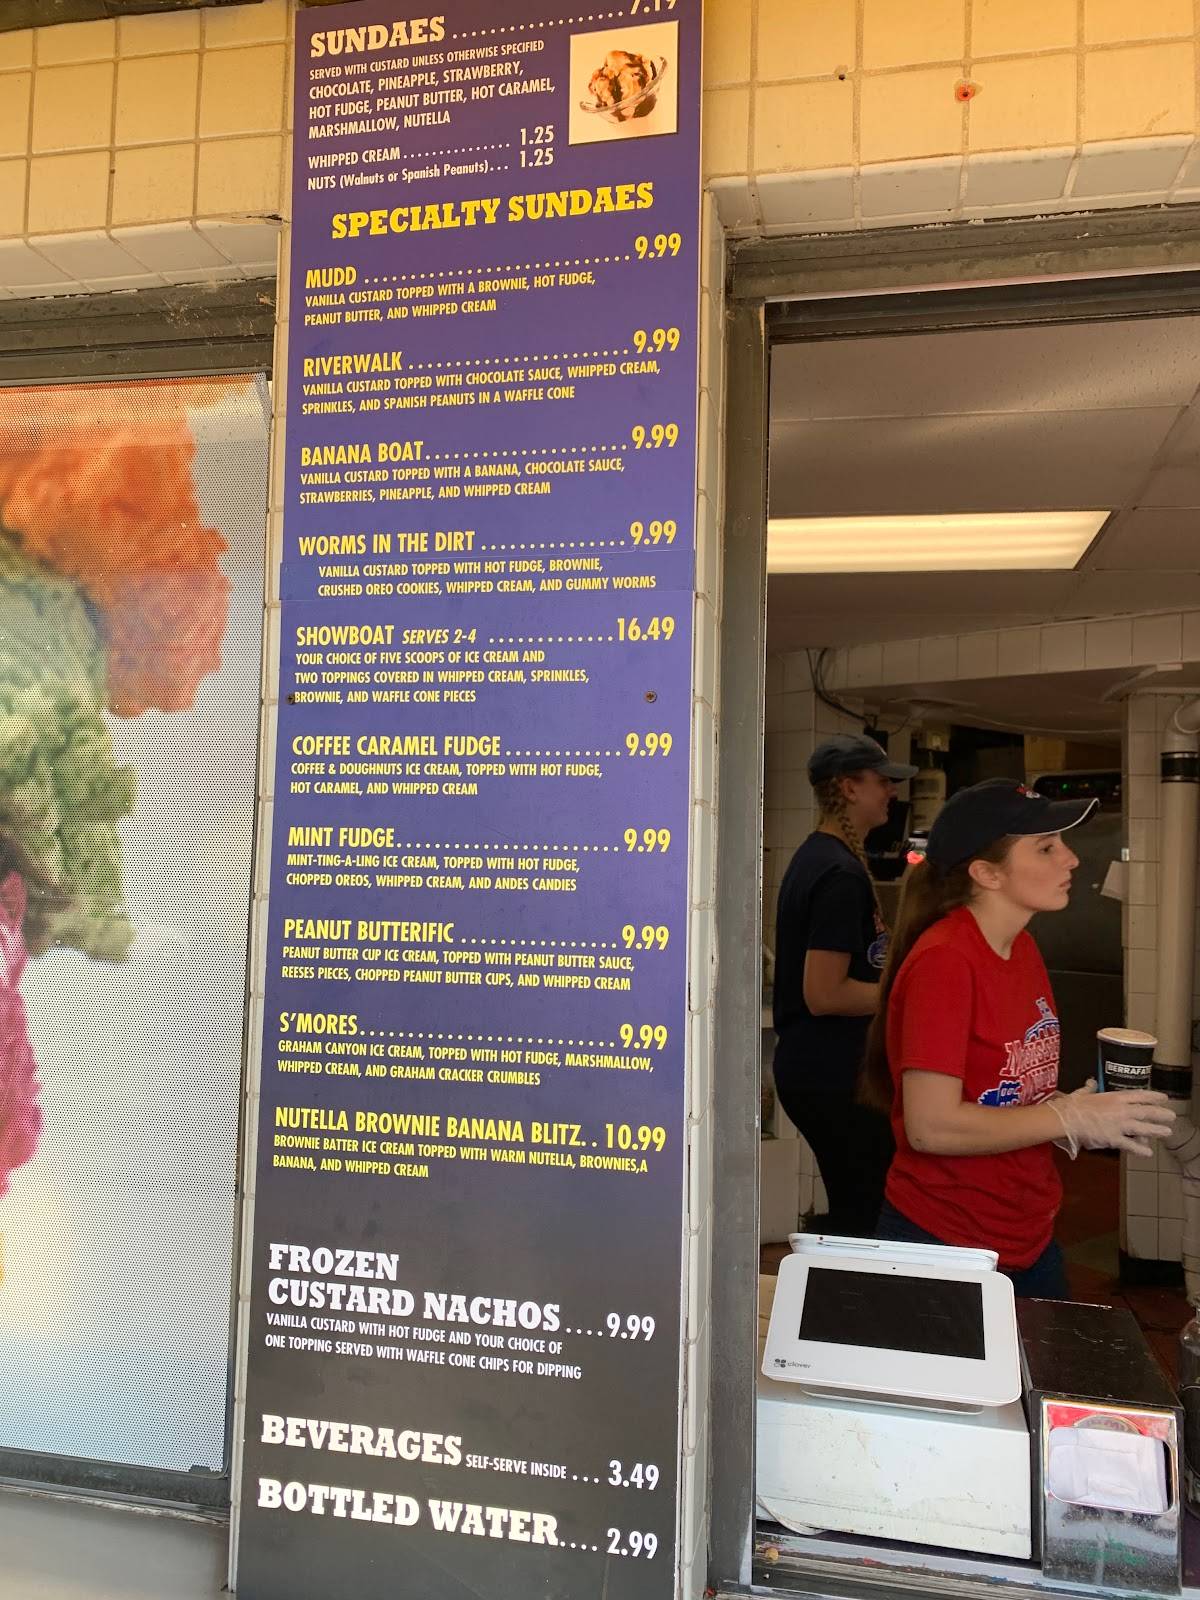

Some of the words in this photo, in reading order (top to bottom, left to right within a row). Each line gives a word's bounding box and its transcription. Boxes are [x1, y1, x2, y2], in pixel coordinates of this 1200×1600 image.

[311, 16, 445, 57] SUNDAES
[310, 67, 341, 80] SERVED
[345, 63, 367, 75] WITH
[370, 58, 409, 72] CUSTARD
[412, 53, 444, 67] UNLESS
[447, 46, 498, 62] OTHERWISE
[501, 40, 544, 55] SPECIFIED
[310, 80, 374, 99] CHOCOLATE,
[379, 72, 439, 91] PINEAPPLE,
[443, 61, 523, 83] STRAWBERRY,
[310, 105, 331, 119] HOT
[335, 100, 372, 116] FUDGE,
[377, 94, 419, 111] PEANUT
[423, 89, 467, 105] BUTTER,
[472, 85, 495, 100] HOT
[499, 78, 555, 96] CARAMEL,
[309, 117, 399, 139] MARSHMALLOW,
[404, 110, 450, 128] NUTELLA
[308, 152, 358, 169] WHIPPED
[362, 147, 400, 163] CREAM
[521, 125, 554, 145] 1.25
[308, 175, 336, 190] NUTS
[340, 172, 384, 188] (Walnuts
[388, 172, 398, 182] or
[402, 164, 440, 183] Spanish
[444, 160, 488, 176] Peanuts)
[520, 147, 553, 167] 1.25
[332, 198, 500, 239] SPECIALTY
[509, 182, 653, 221] SUNDAES
[306, 267, 356, 288] MUDD
[635, 233, 681, 259] 9.99
[305, 312, 342, 326] PEANUT
[345, 309, 383, 322] BUTTER,
[387, 307, 408, 319] AND
[412, 303, 458, 317] WHIPPED
[461, 299, 496, 313] CREAM
[304, 351, 402, 377] RIVERWALK
[634, 328, 680, 353] 9.99
[303, 382, 343, 395] VANILLA
[347, 379, 390, 392] CUSTARD
[394, 376, 432, 389] TOPPED
[436, 374, 462, 387] WITH
[466, 370, 524, 385] CHOCOLATE
[528, 367, 563, 381] SAUCE,
[568, 364, 616, 378] WHIPPED
[620, 361, 660, 374] CREAM,
[302, 444, 371, 466] BANANA
[378, 441, 423, 462] BOAT
[632, 424, 678, 449] 9.99
[300, 490, 376, 504] STRAWBERRIES,
[380, 487, 434, 500] PINEAPPLE,
[438, 486, 460, 498] AND
[464, 484, 511, 497] WHIPPED
[515, 482, 550, 495] CREAM
[299, 535, 366, 556] WORMS
[373, 534, 391, 553] IN
[397, 533, 428, 552] THE
[435, 531, 475, 551] DIRT
[630, 520, 676, 545] 9.99
[318, 584, 362, 596] CRUSHED
[366, 583, 393, 595] OREO
[397, 582, 442, 595] COOKIES,
[446, 581, 493, 593] WHIPPED
[497, 580, 536, 593] CREAM,
[540, 579, 562, 591] AND
[566, 577, 609, 590] GUMMY
[613, 576, 656, 589] WORMS
[297, 625, 394, 646] SHOWBOAT
[402, 629, 449, 644] SERVES
[453, 629, 476, 643] 2-4
[618, 617, 674, 641] 16.49
[295, 691, 343, 704] BROWNIE,
[347, 691, 368, 702] AND
[372, 691, 409, 702] WAFFLE
[414, 691, 440, 702] CONE
[444, 690, 476, 702] PIECES
[293, 736, 350, 755] COFFEE
[357, 736, 438, 755] CARAMEL
[444, 736, 500, 756] FUDGE
[626, 733, 672, 756] 9.99
[291, 782, 311, 793] HOT
[314, 782, 363, 796] CARAMEL,
[366, 783, 388, 794] AND
[392, 783, 439, 794] WHIPPED
[442, 783, 478, 795] CREAM
[288, 827, 333, 846] MINT
[340, 828, 394, 847] FUDGE
[624, 828, 670, 852] 9.99
[287, 854, 380, 867] MINT-TING-A-LING
[383, 856, 398, 867] ICE
[401, 856, 440, 870] CREAM,
[444, 857, 483, 869] TOPPED
[487, 857, 514, 869] WITH
[518, 858, 539, 870] HOT
[543, 858, 580, 873] FUDGE,
[284, 919, 352, 940] PEANUT
[358, 921, 454, 943] BUTTERIFIC
[622, 925, 669, 950] 9.99
[282, 966, 314, 979] REESES
[318, 967, 351, 982] PIECES,
[355, 968, 400, 981] CHOPPED
[404, 970, 442, 983] PEANUT
[446, 971, 481, 984] BUTTER
[486, 973, 513, 988] CUPS,
[518, 974, 539, 986] AND
[544, 975, 590, 988] WHIPPED
[594, 977, 630, 990] CREAM
[280, 1012, 357, 1035] S'MORES
[620, 1024, 667, 1050] 9.99
[278, 1060, 322, 1073] WHIPPED
[325, 1062, 362, 1078] CREAM,
[365, 1064, 387, 1077] AND
[390, 1066, 435, 1079] GRAHAM
[438, 1068, 483, 1082] CRACKER
[487, 1070, 540, 1085] CRUMBLES
[276, 1107, 348, 1131] NUTELLA
[355, 1112, 440, 1136] BROWNIE
[447, 1117, 524, 1142] BANANA
[531, 1122, 582, 1146] BLITZ
[606, 1124, 666, 1151] 10.99
[274, 1135, 320, 1149] BROWNIE
[324, 1138, 358, 1152] BATTER
[362, 1140, 376, 1153] ICE
[380, 1142, 414, 1155] CREAM
[418, 1144, 456, 1158] TOPPED
[460, 1147, 487, 1160] WITH
[491, 1149, 525, 1163] WARM
[529, 1151, 576, 1169] NUTELLA,
[269, 1243, 399, 1281] FROZEN
[269, 1278, 414, 1316] CUSTARD
[424, 1292, 560, 1331] NACHOS
[607, 1313, 655, 1341] 9.99
[265, 1334, 285, 1348] ONE
[289, 1336, 332, 1352] TOPPING
[335, 1341, 373, 1356] SERVED
[376, 1346, 403, 1360] WITH
[406, 1349, 445, 1364] WAFFLE
[448, 1353, 476, 1368] CONE
[479, 1356, 509, 1371] CHIPS
[513, 1360, 533, 1374] FOR
[537, 1362, 581, 1379] DIPPING
[261, 1414, 462, 1465] BEVERAGES
[466, 1454, 527, 1474] SELF-SERVE
[531, 1462, 566, 1479] INSIDE
[608, 1460, 659, 1490] 3.49
[258, 1478, 420, 1526] BOTTLED
[428, 1499, 558, 1546] WATER
[607, 1528, 657, 1559] 2.99
